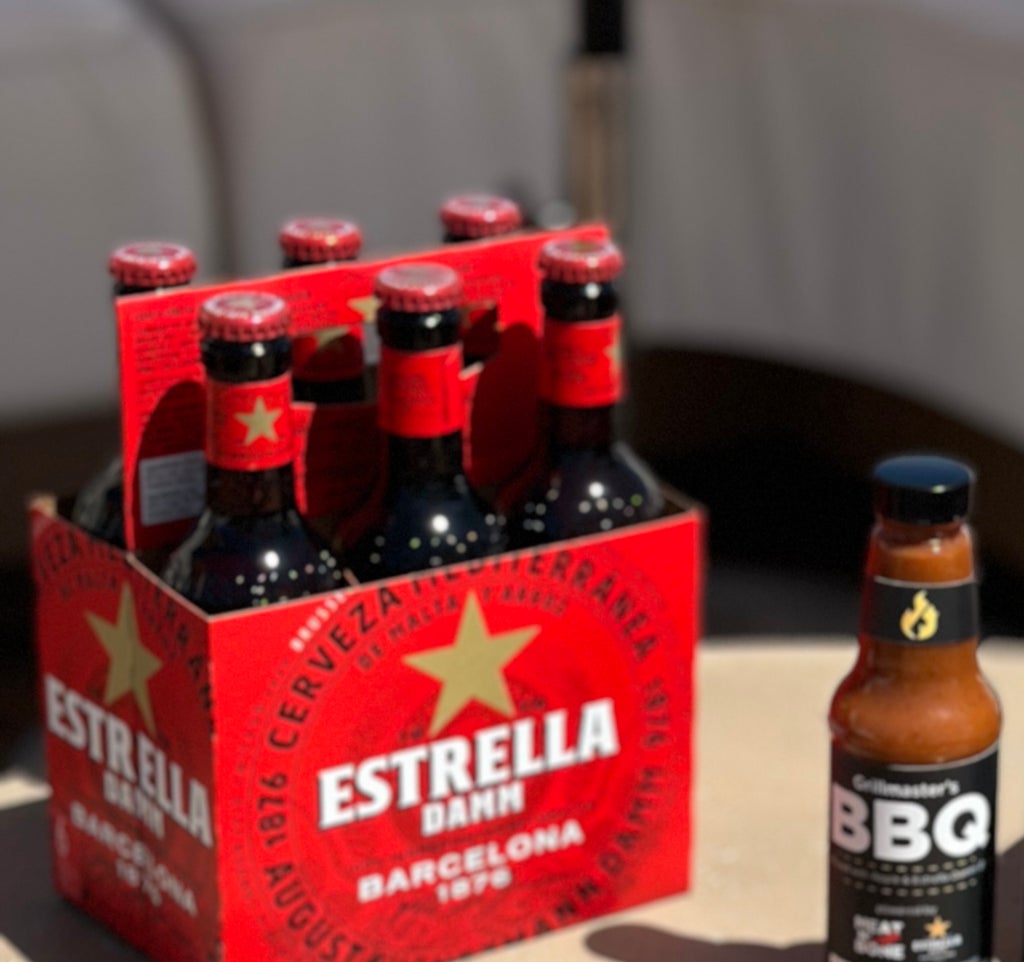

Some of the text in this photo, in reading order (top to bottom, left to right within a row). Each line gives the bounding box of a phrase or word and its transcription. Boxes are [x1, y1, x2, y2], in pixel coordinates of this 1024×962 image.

[269, 587, 401, 750] CERVEZA
[44, 673, 214, 848] ESTRELLA
[316, 697, 622, 832] ESTRELLA
[851, 773, 961, 799] Grillmaster's
[257, 772, 288, 847] 1876
[420, 781, 525, 837] DAMM
[831, 782, 992, 864] BBQ
[357, 818, 586, 904] BARCELONA
